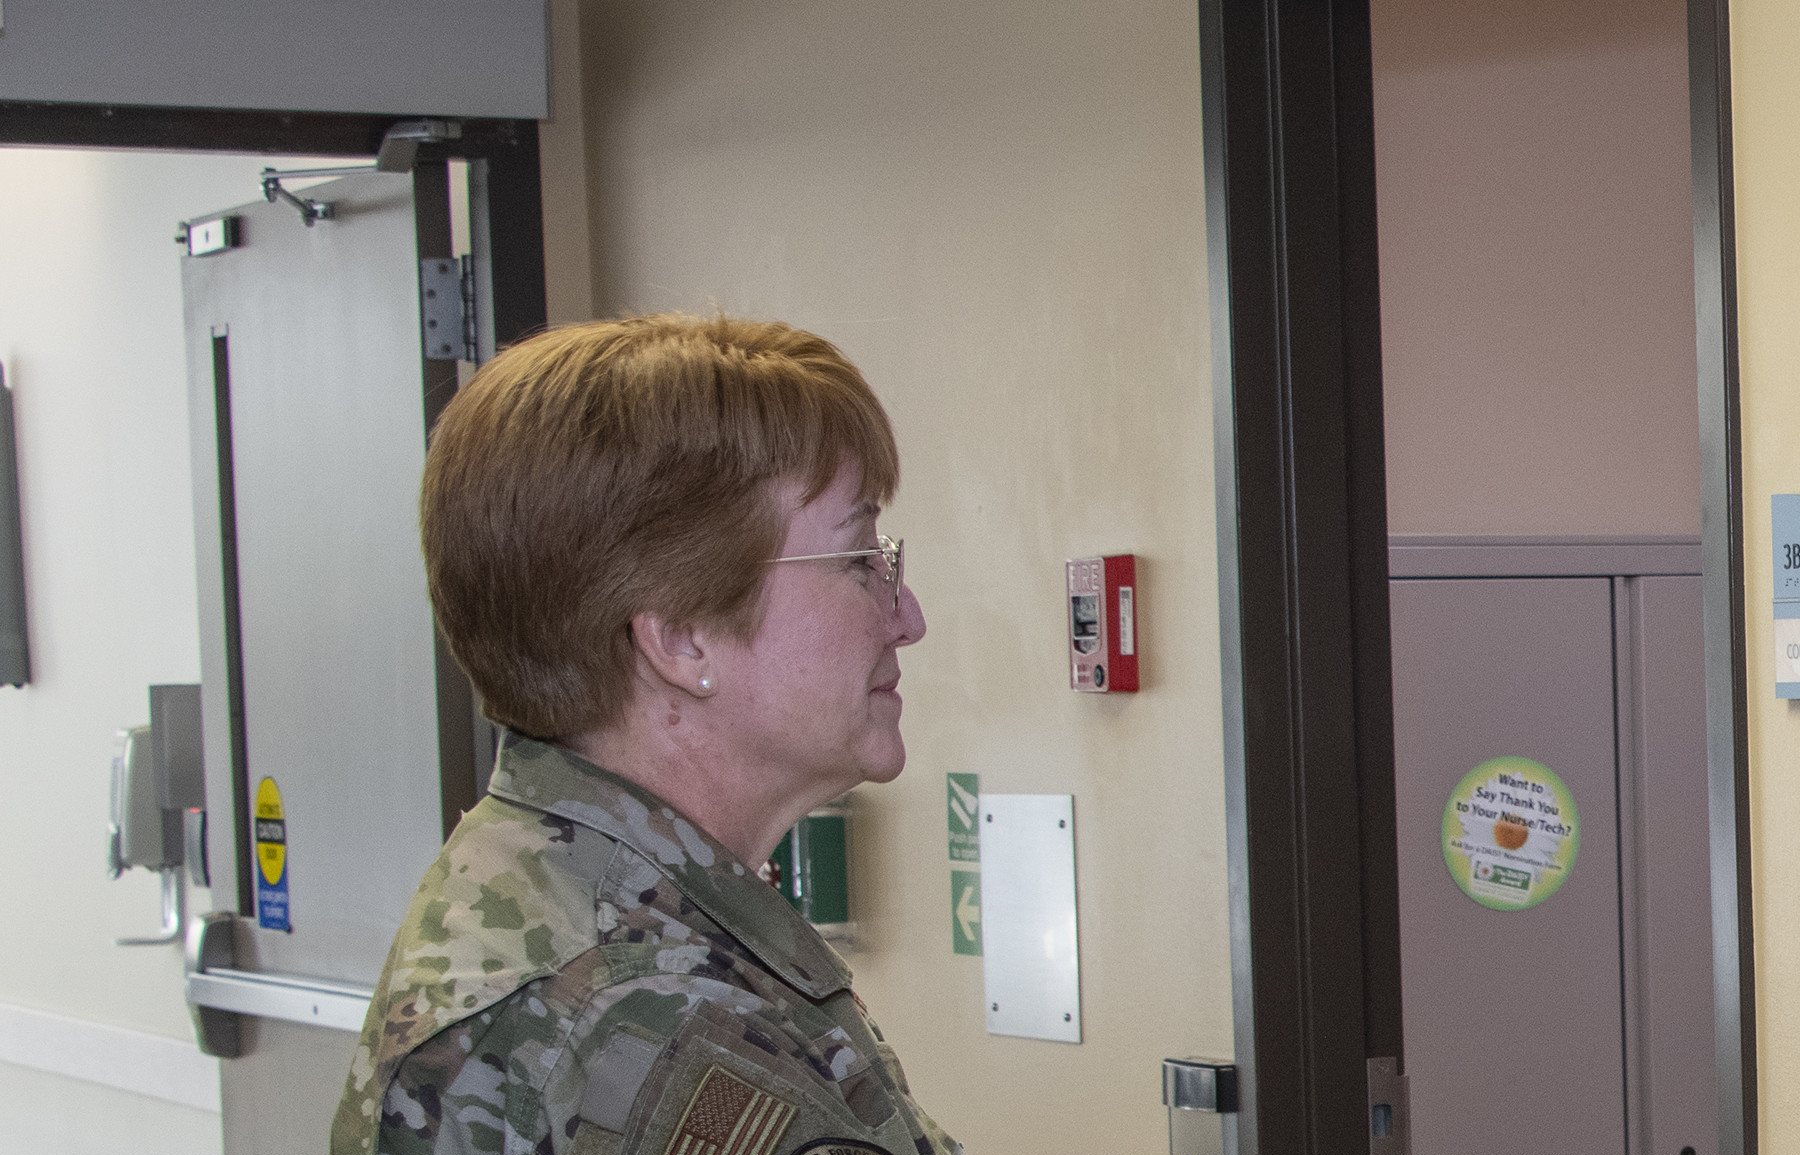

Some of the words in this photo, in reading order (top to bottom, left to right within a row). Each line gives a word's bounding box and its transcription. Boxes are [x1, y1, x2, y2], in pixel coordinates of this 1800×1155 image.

[1499, 773, 1529, 791] Want
[1531, 782, 1544, 794] to
[1476, 786, 1497, 803] Say
[1499, 791, 1535, 811] Thank
[1538, 801, 1559, 816] You
[1456, 801, 1469, 813] to
[1472, 804, 1498, 820] Your
[1501, 811, 1571, 837] Nurse/Tech?
